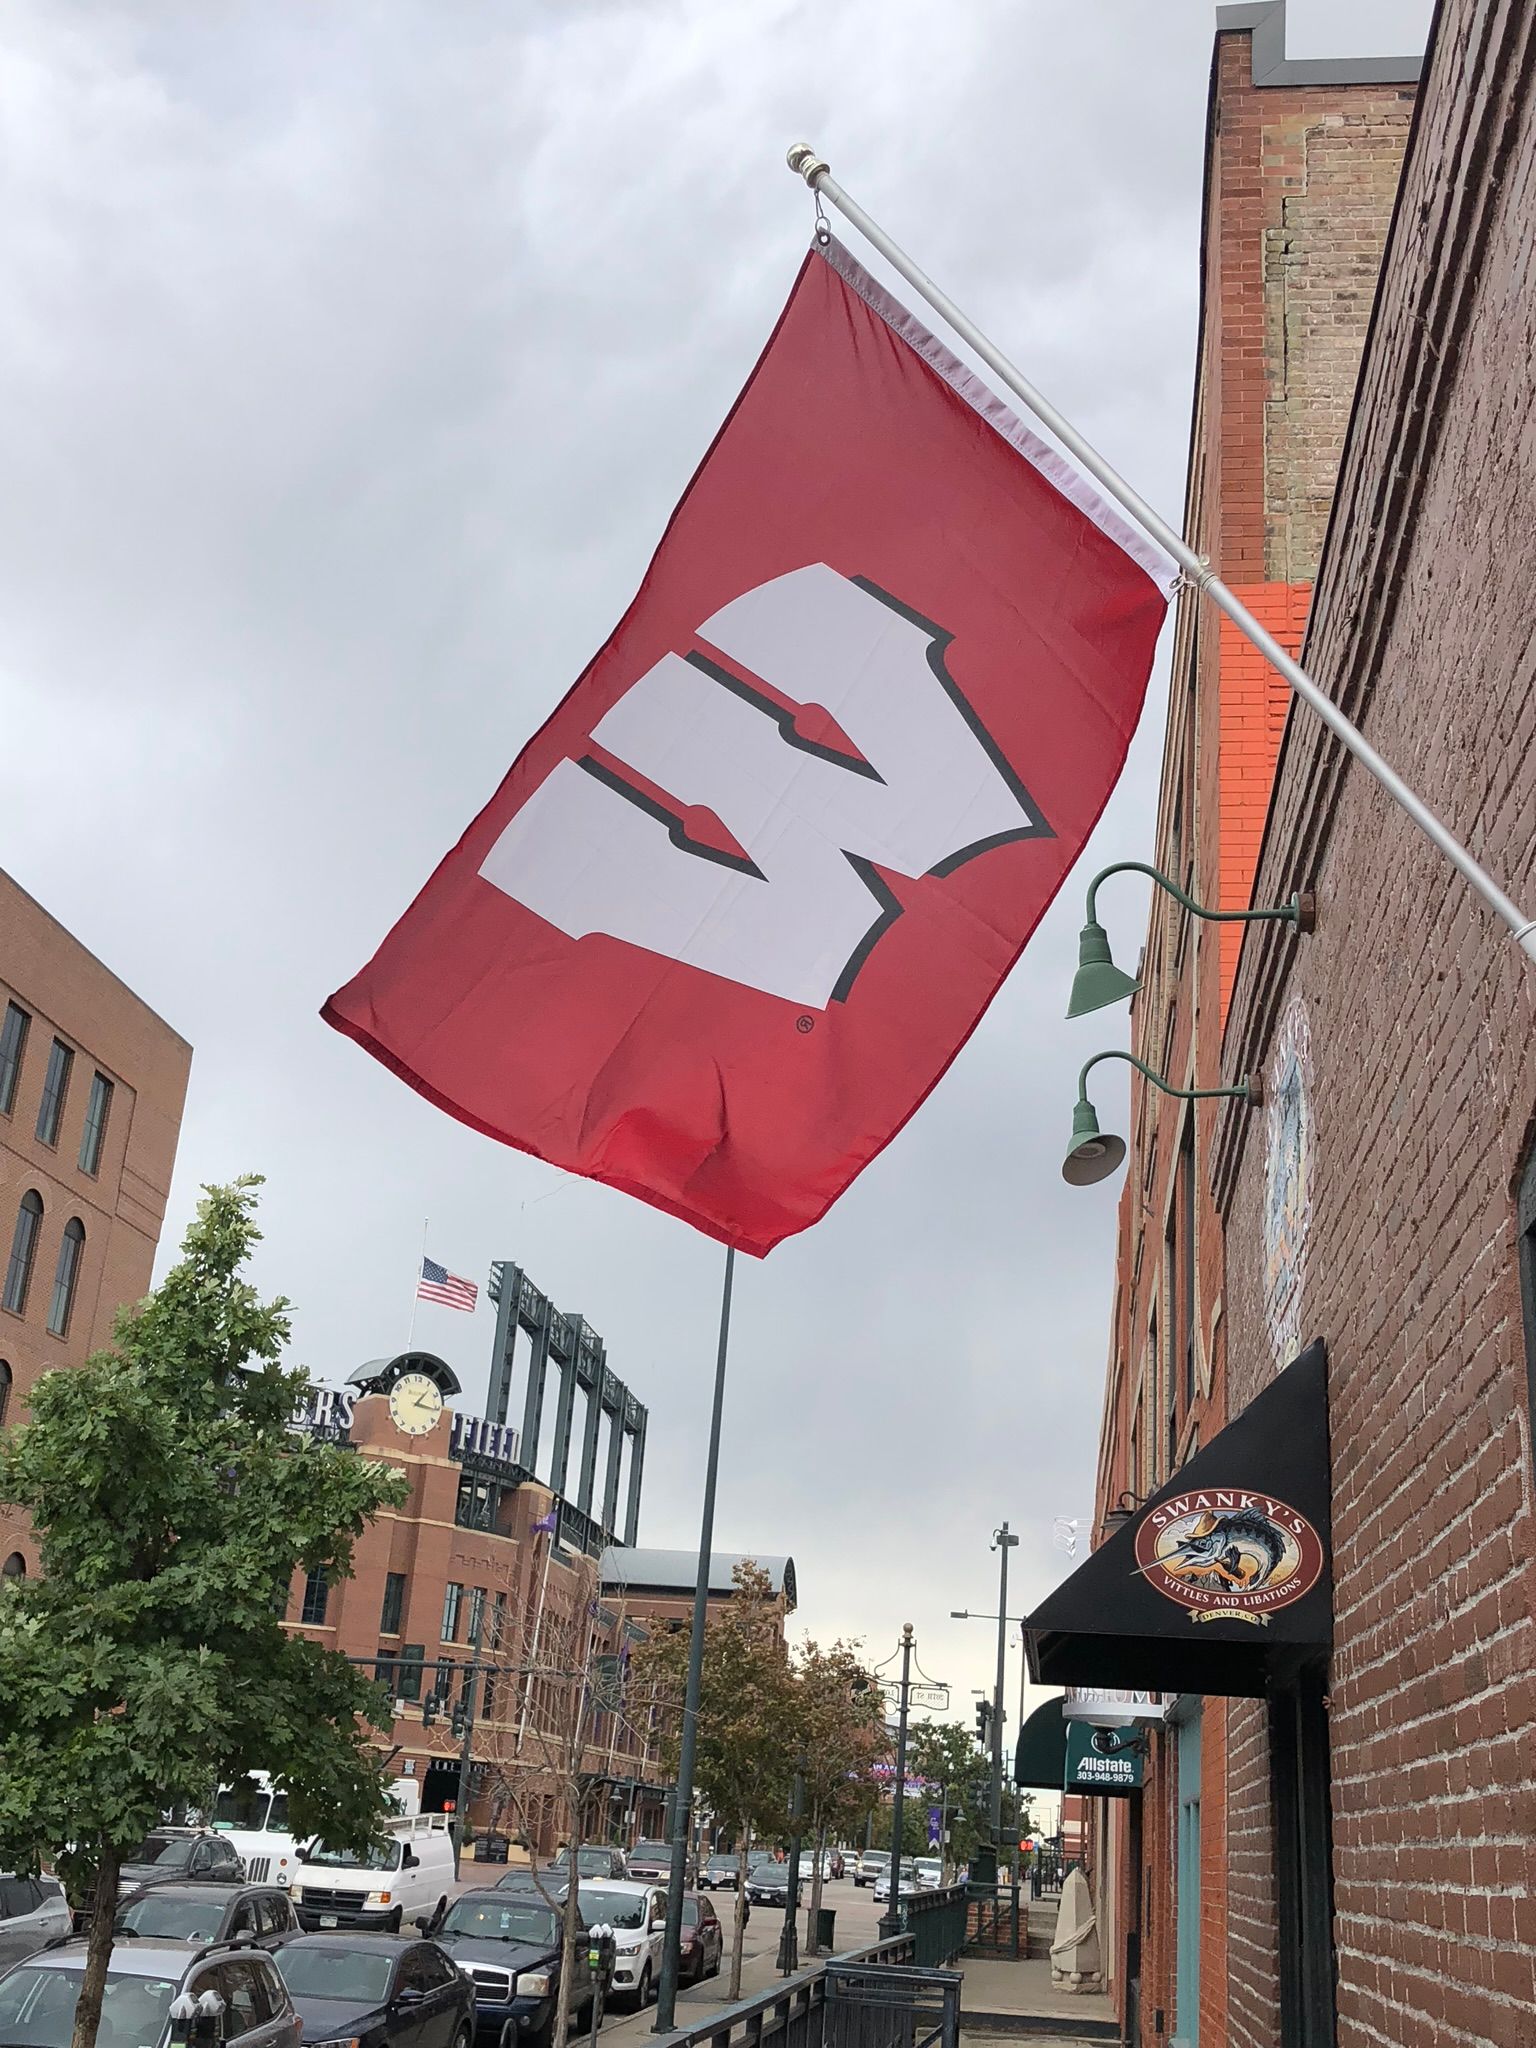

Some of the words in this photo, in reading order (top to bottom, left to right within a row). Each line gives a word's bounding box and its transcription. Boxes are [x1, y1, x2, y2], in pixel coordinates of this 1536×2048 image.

[458, 1413, 521, 1465] FIELD
[1152, 1493, 1306, 1534] SWANKY'S
[1163, 1576, 1209, 1603] VITTLES
[1213, 1596, 1240, 1607] AND
[1243, 1576, 1302, 1606] LIBATIONS
[1076, 1771, 1134, 1783] 303-948-9879
[1077, 1757, 1133, 1773] Allstate
